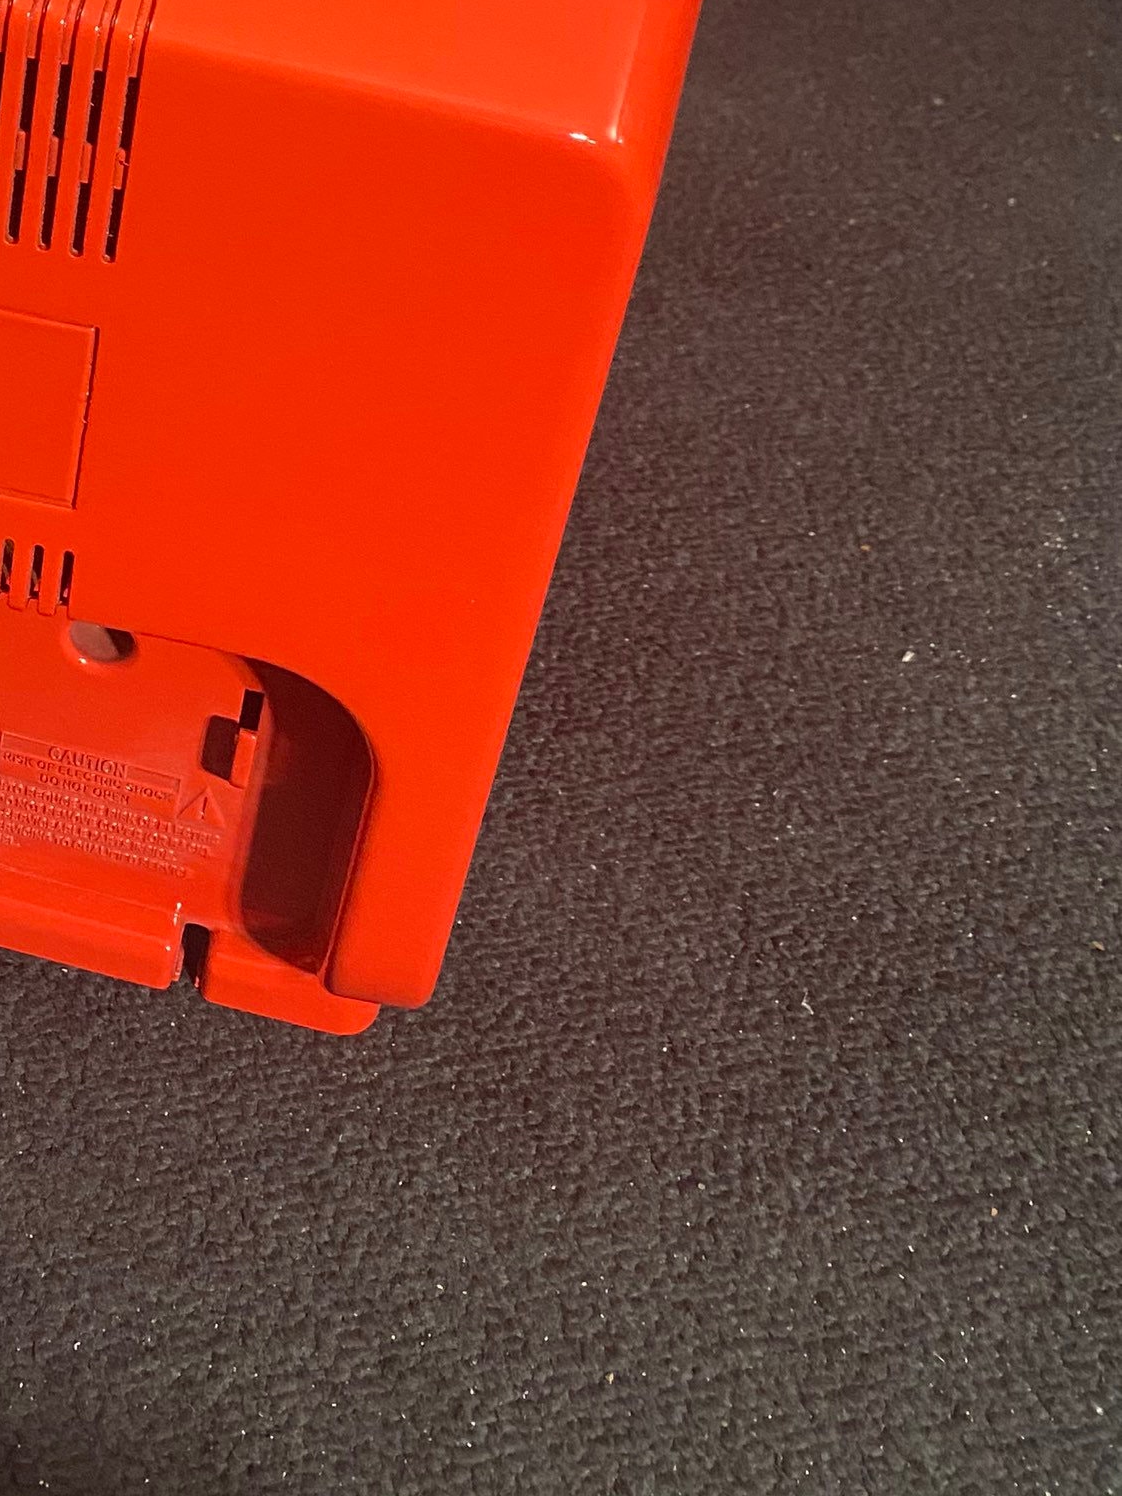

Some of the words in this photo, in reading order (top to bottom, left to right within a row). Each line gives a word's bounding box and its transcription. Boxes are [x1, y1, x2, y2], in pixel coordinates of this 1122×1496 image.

[3, 751, 33, 767] RISK
[37, 759, 55, 773] OF
[57, 764, 120, 789] ELECTRIC
[125, 781, 173, 803] SHOCK
[48, 744, 126, 779] CAUTION
[39, 773, 58, 786] DO
[62, 778, 87, 794] NOT
[92, 786, 130, 806] OPEN
